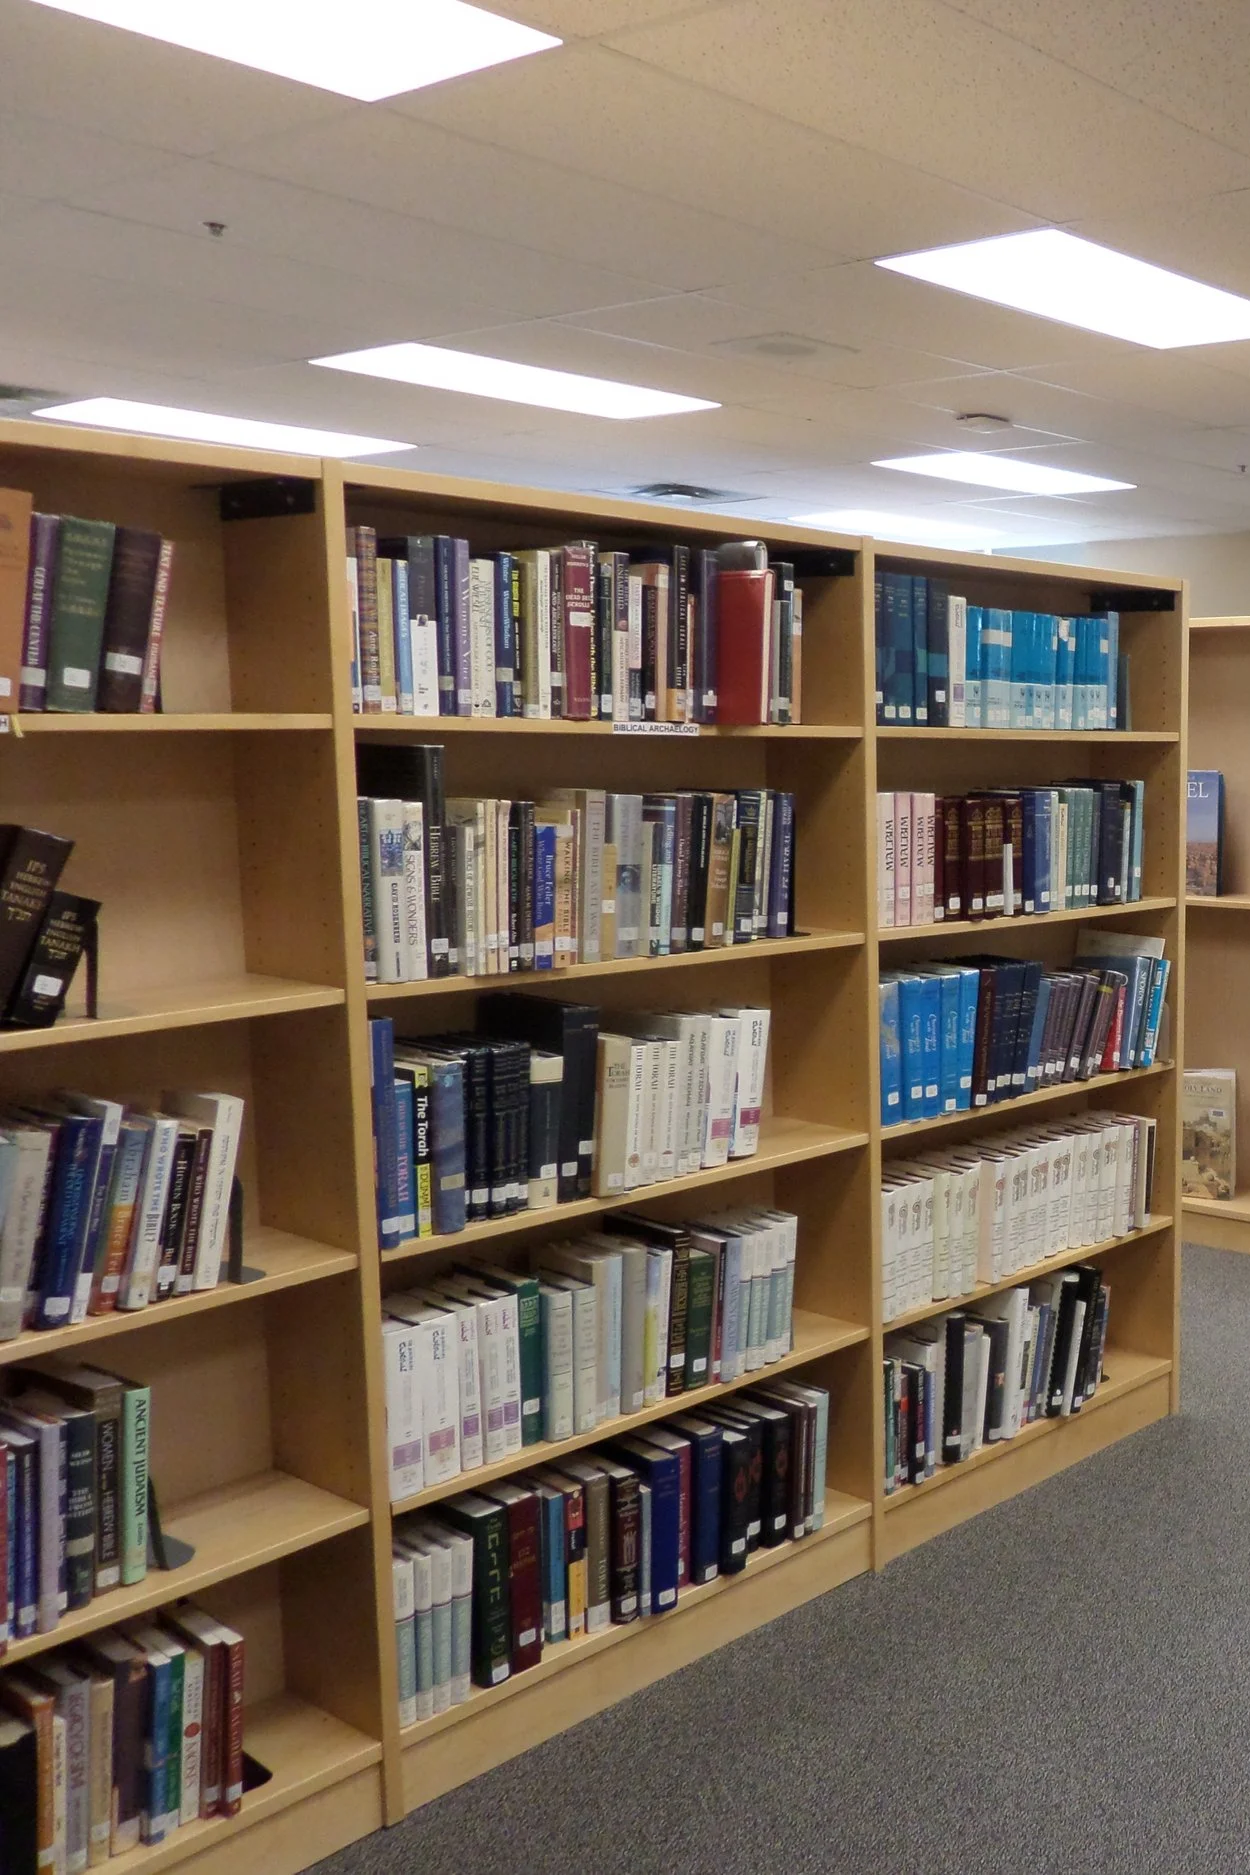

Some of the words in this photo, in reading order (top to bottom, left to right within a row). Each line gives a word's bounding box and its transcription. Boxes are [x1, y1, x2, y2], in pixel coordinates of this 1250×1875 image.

[161, 543, 174, 565] TEXT
[157, 569, 171, 593] AND
[502, 557, 511, 583] Winter
[616, 563, 625, 610] UNEARTHED
[152, 594, 167, 637] TEXTURE
[679, 587, 687, 620] BIBLICAL
[369, 631, 378, 654] Anne
[613, 723, 647, 733] BIBLICAL
[648, 723, 699, 735] ARCHAELOGY
[1187, 781, 1210, 798] EL
[591, 821, 600, 841] THE
[885, 819, 894, 871] MALBIM
[900, 815, 909, 868] MALBIM
[916, 816, 924, 867] MALBIM
[927, 815, 935, 865] MALBIM
[429, 825, 441, 871] HEBREW
[563, 841, 572, 885] WALKING
[591, 846, 600, 878] BIBLE
[405, 854, 416, 884] SIGNS
[545, 854, 554, 879] Bruce
[430, 874, 441, 904] BIBLE
[544, 881, 553, 906] Feiler
[563, 888, 571, 905] THE
[364, 882, 374, 935] NARRATIVE
[406, 895, 418, 946] WONDERS
[562, 909, 571, 933] BIBLE
[588, 911, 599, 936] WAS
[40, 935, 82, 953] TANAKH
[636, 1047, 644, 1062] THE
[652, 1047, 660, 1060] THE
[669, 1046, 677, 1059] THE
[605, 1066, 631, 1077] TORAH
[634, 1064, 643, 1091] TORAH
[650, 1064, 660, 1091] TORAH
[667, 1063, 677, 1089] TORAH
[416, 1095, 428, 1119] The
[159, 1127, 171, 1152] WHO
[417, 1120, 429, 1157] Torah
[119, 1141, 143, 1202] Abraham
[153, 1154, 166, 1191] WROTE
[172, 1160, 188, 1201] HIDDEN
[194, 1174, 203, 1195] WHO
[398, 1153, 409, 1203] TORAH
[419, 1172, 430, 1209] DUMMI
[189, 1196, 200, 1227] WROTE
[112, 1210, 126, 1245] Bruce
[143, 1213, 161, 1243] BIBLE?
[134, 1398, 147, 1456] ANCIENT
[101, 1421, 115, 1473] WOMEN
[133, 1460, 147, 1517] JUDAISM
[102, 1490, 116, 1532] HEBREW
[102, 1532, 115, 1561] BIBLE
